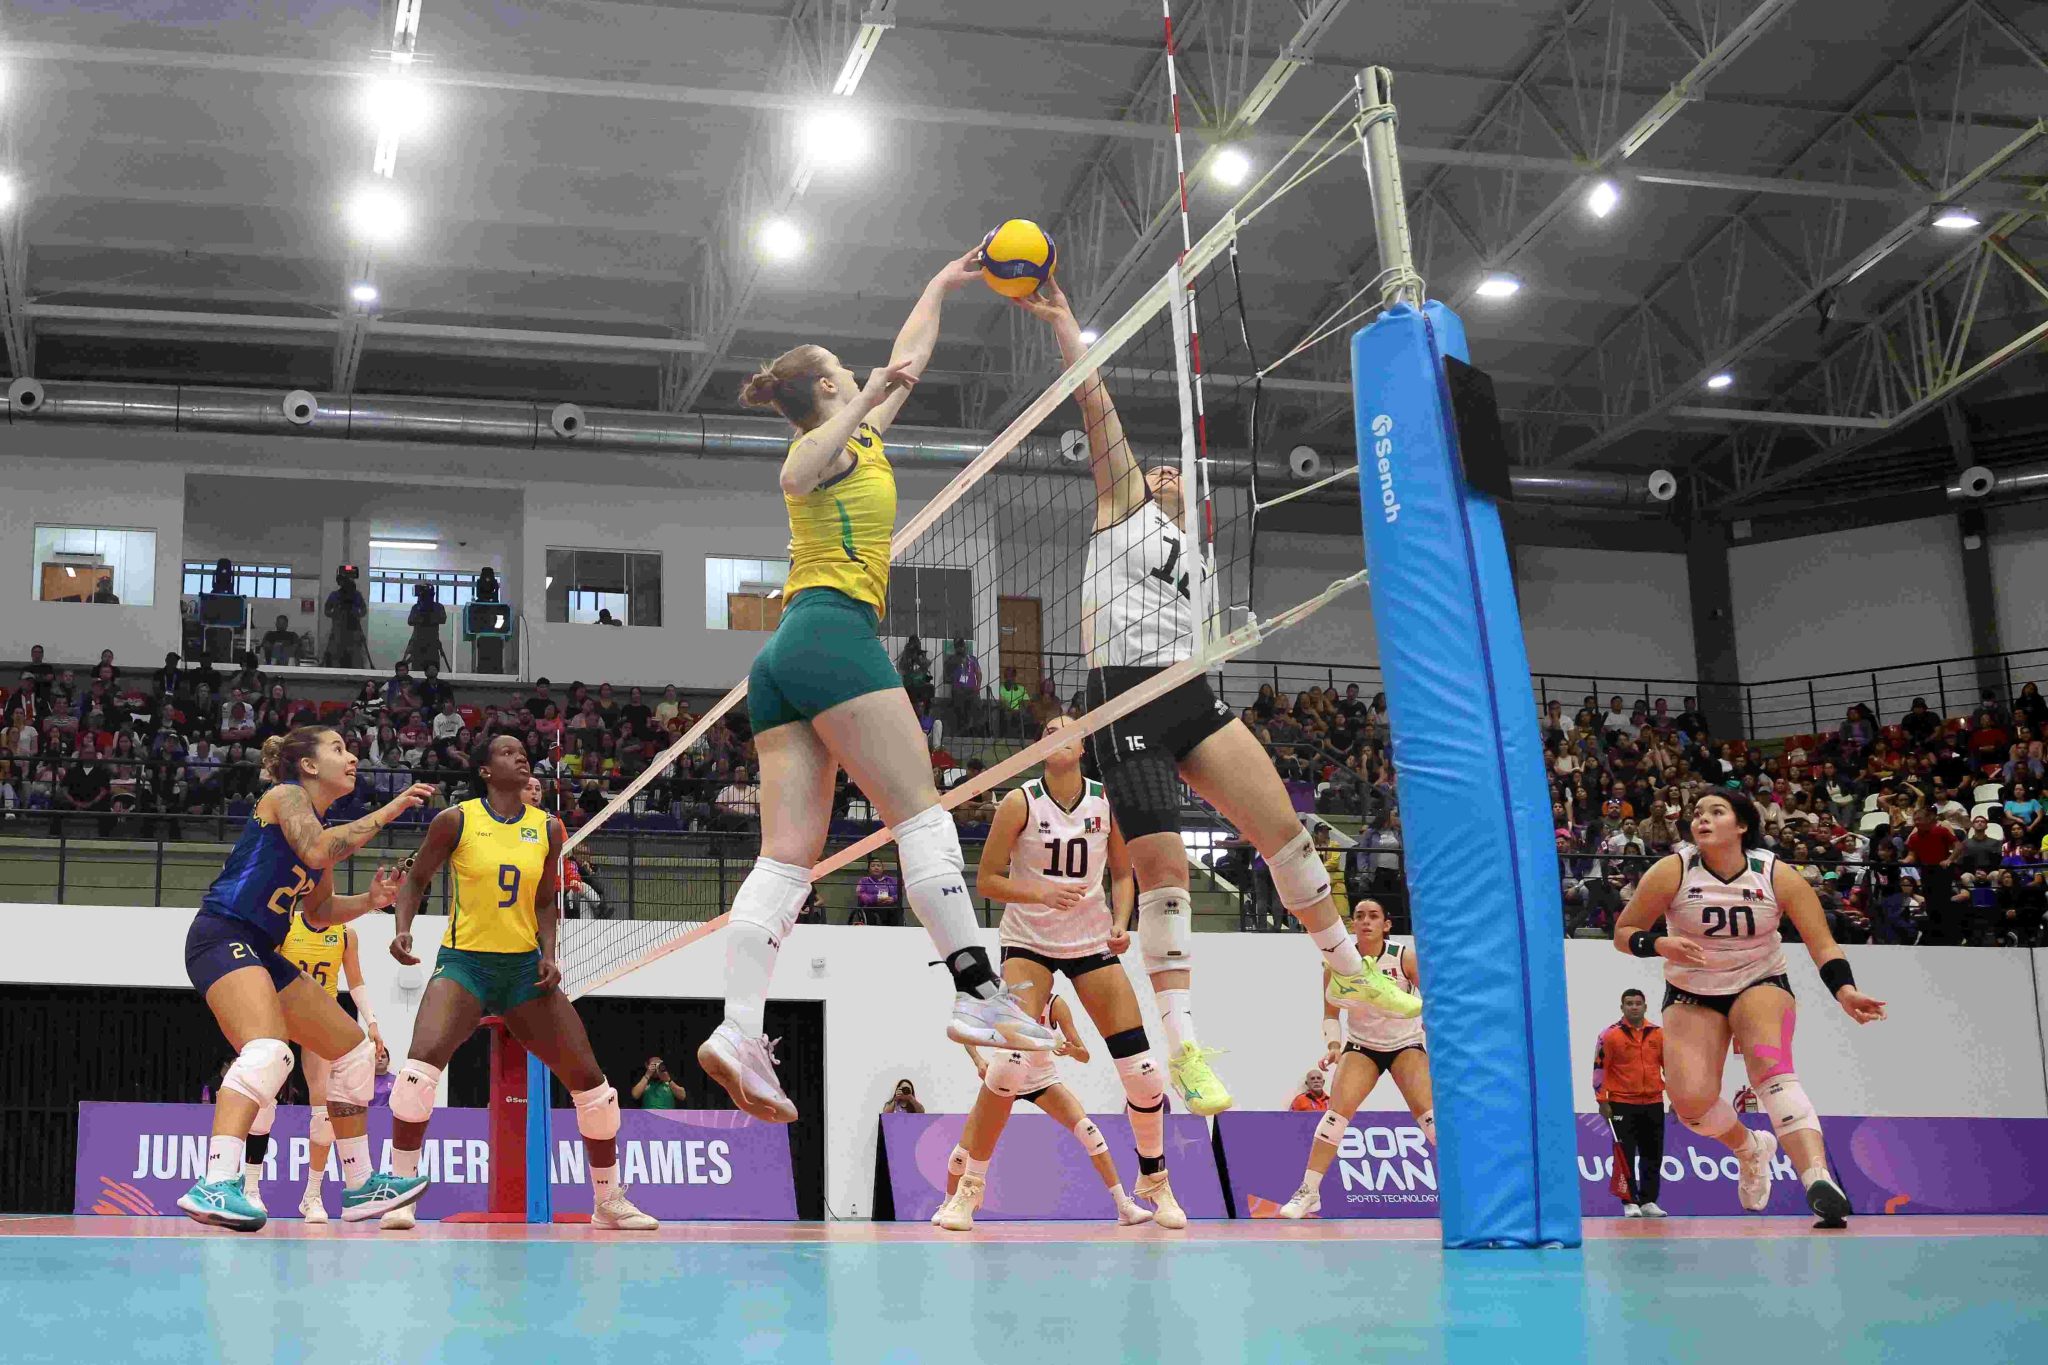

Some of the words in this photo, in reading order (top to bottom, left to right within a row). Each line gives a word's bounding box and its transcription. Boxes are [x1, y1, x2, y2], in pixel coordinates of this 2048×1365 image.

[1375, 438, 1401, 523] Senoh
[1150, 535, 1190, 601] 1
[1043, 837, 1088, 878] 10
[498, 864, 521, 908] 9
[1702, 906, 1756, 937] 20
[132, 1134, 277, 1181] JUNR
[616, 1140, 732, 1185] AMES
[1336, 1126, 1430, 1158] BOR
[1577, 1155, 1685, 1181] uo
[1687, 1146, 1798, 1181] bak
[1346, 1194, 1380, 1203] SPORTS
[1382, 1194, 1439, 1203] TECHNOLOGY
